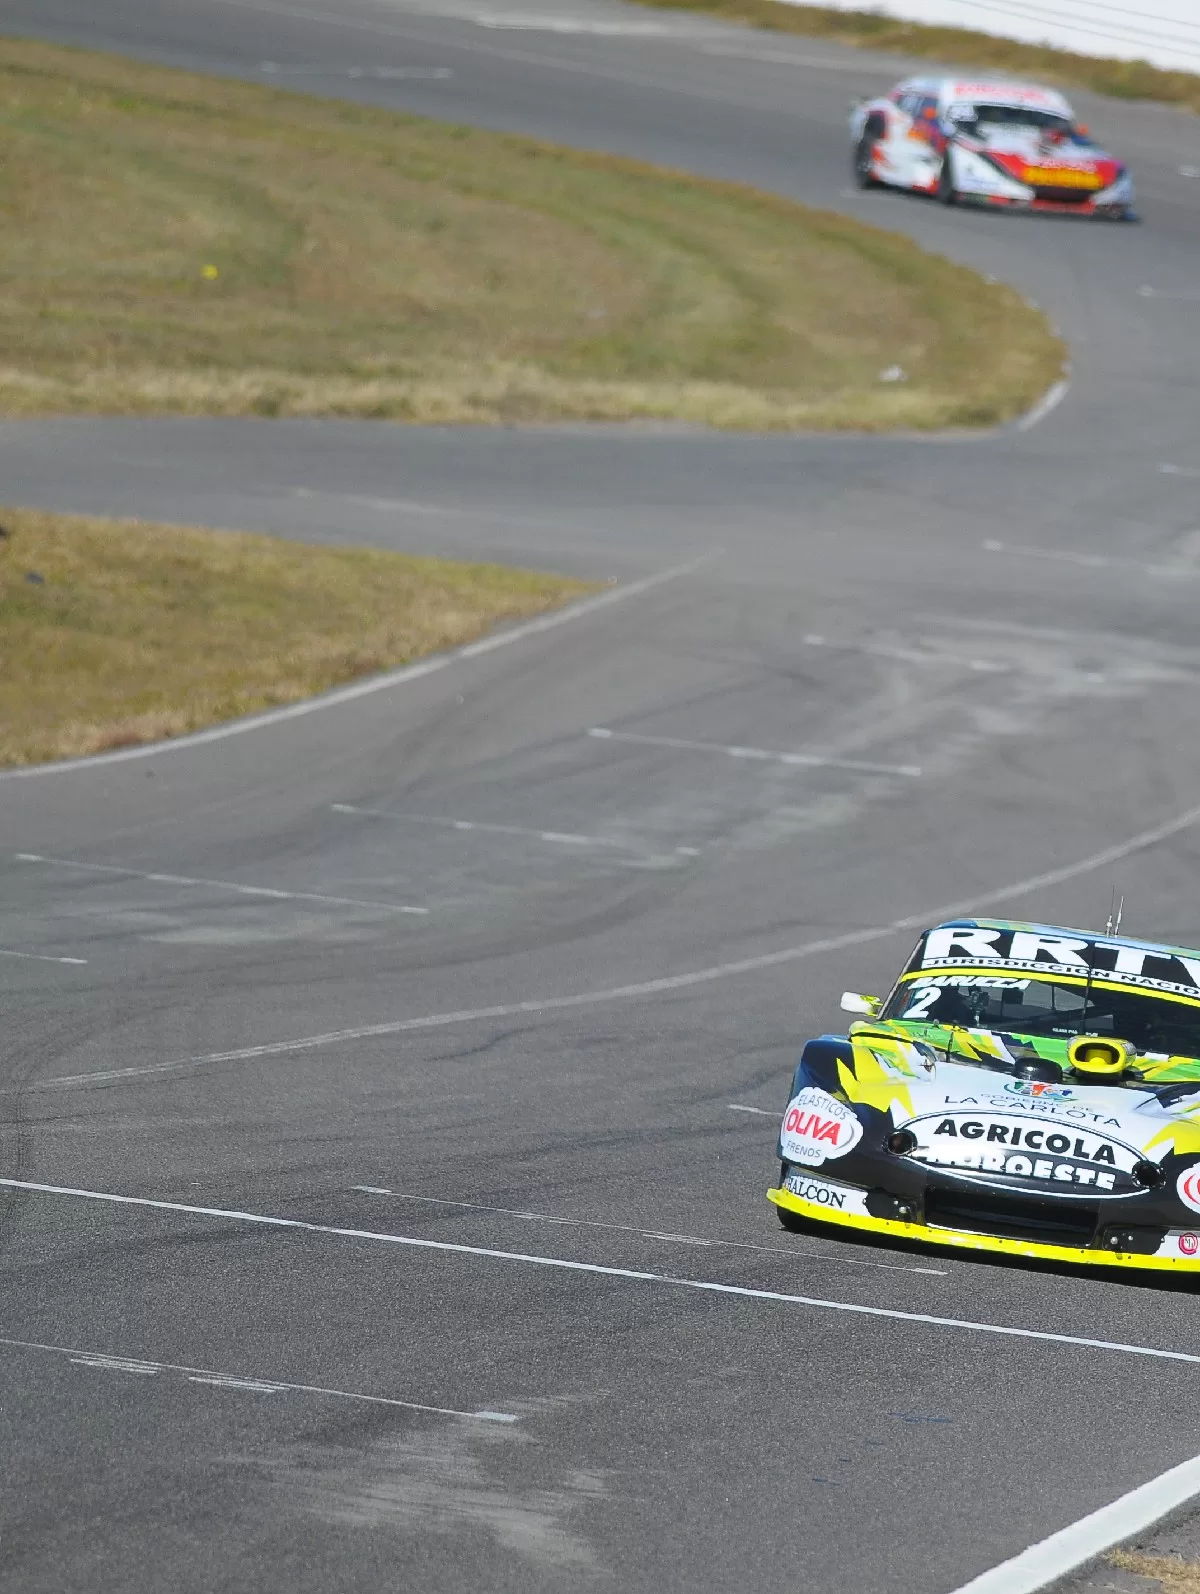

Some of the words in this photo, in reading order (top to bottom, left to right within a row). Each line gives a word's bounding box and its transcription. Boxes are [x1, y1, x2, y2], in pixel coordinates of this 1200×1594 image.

[926, 958, 1110, 978] JURISDICCION
[902, 986, 942, 1019] 2
[796, 1093, 850, 1121] ELASTICOS
[944, 1095, 979, 1105] LA
[989, 1098, 1123, 1129] CARLOTA
[785, 1108, 842, 1146] OLIVA
[933, 1118, 1117, 1166] AGRICOLA
[785, 1140, 823, 1159] FRENOS
[785, 1177, 847, 1209] HALCON
